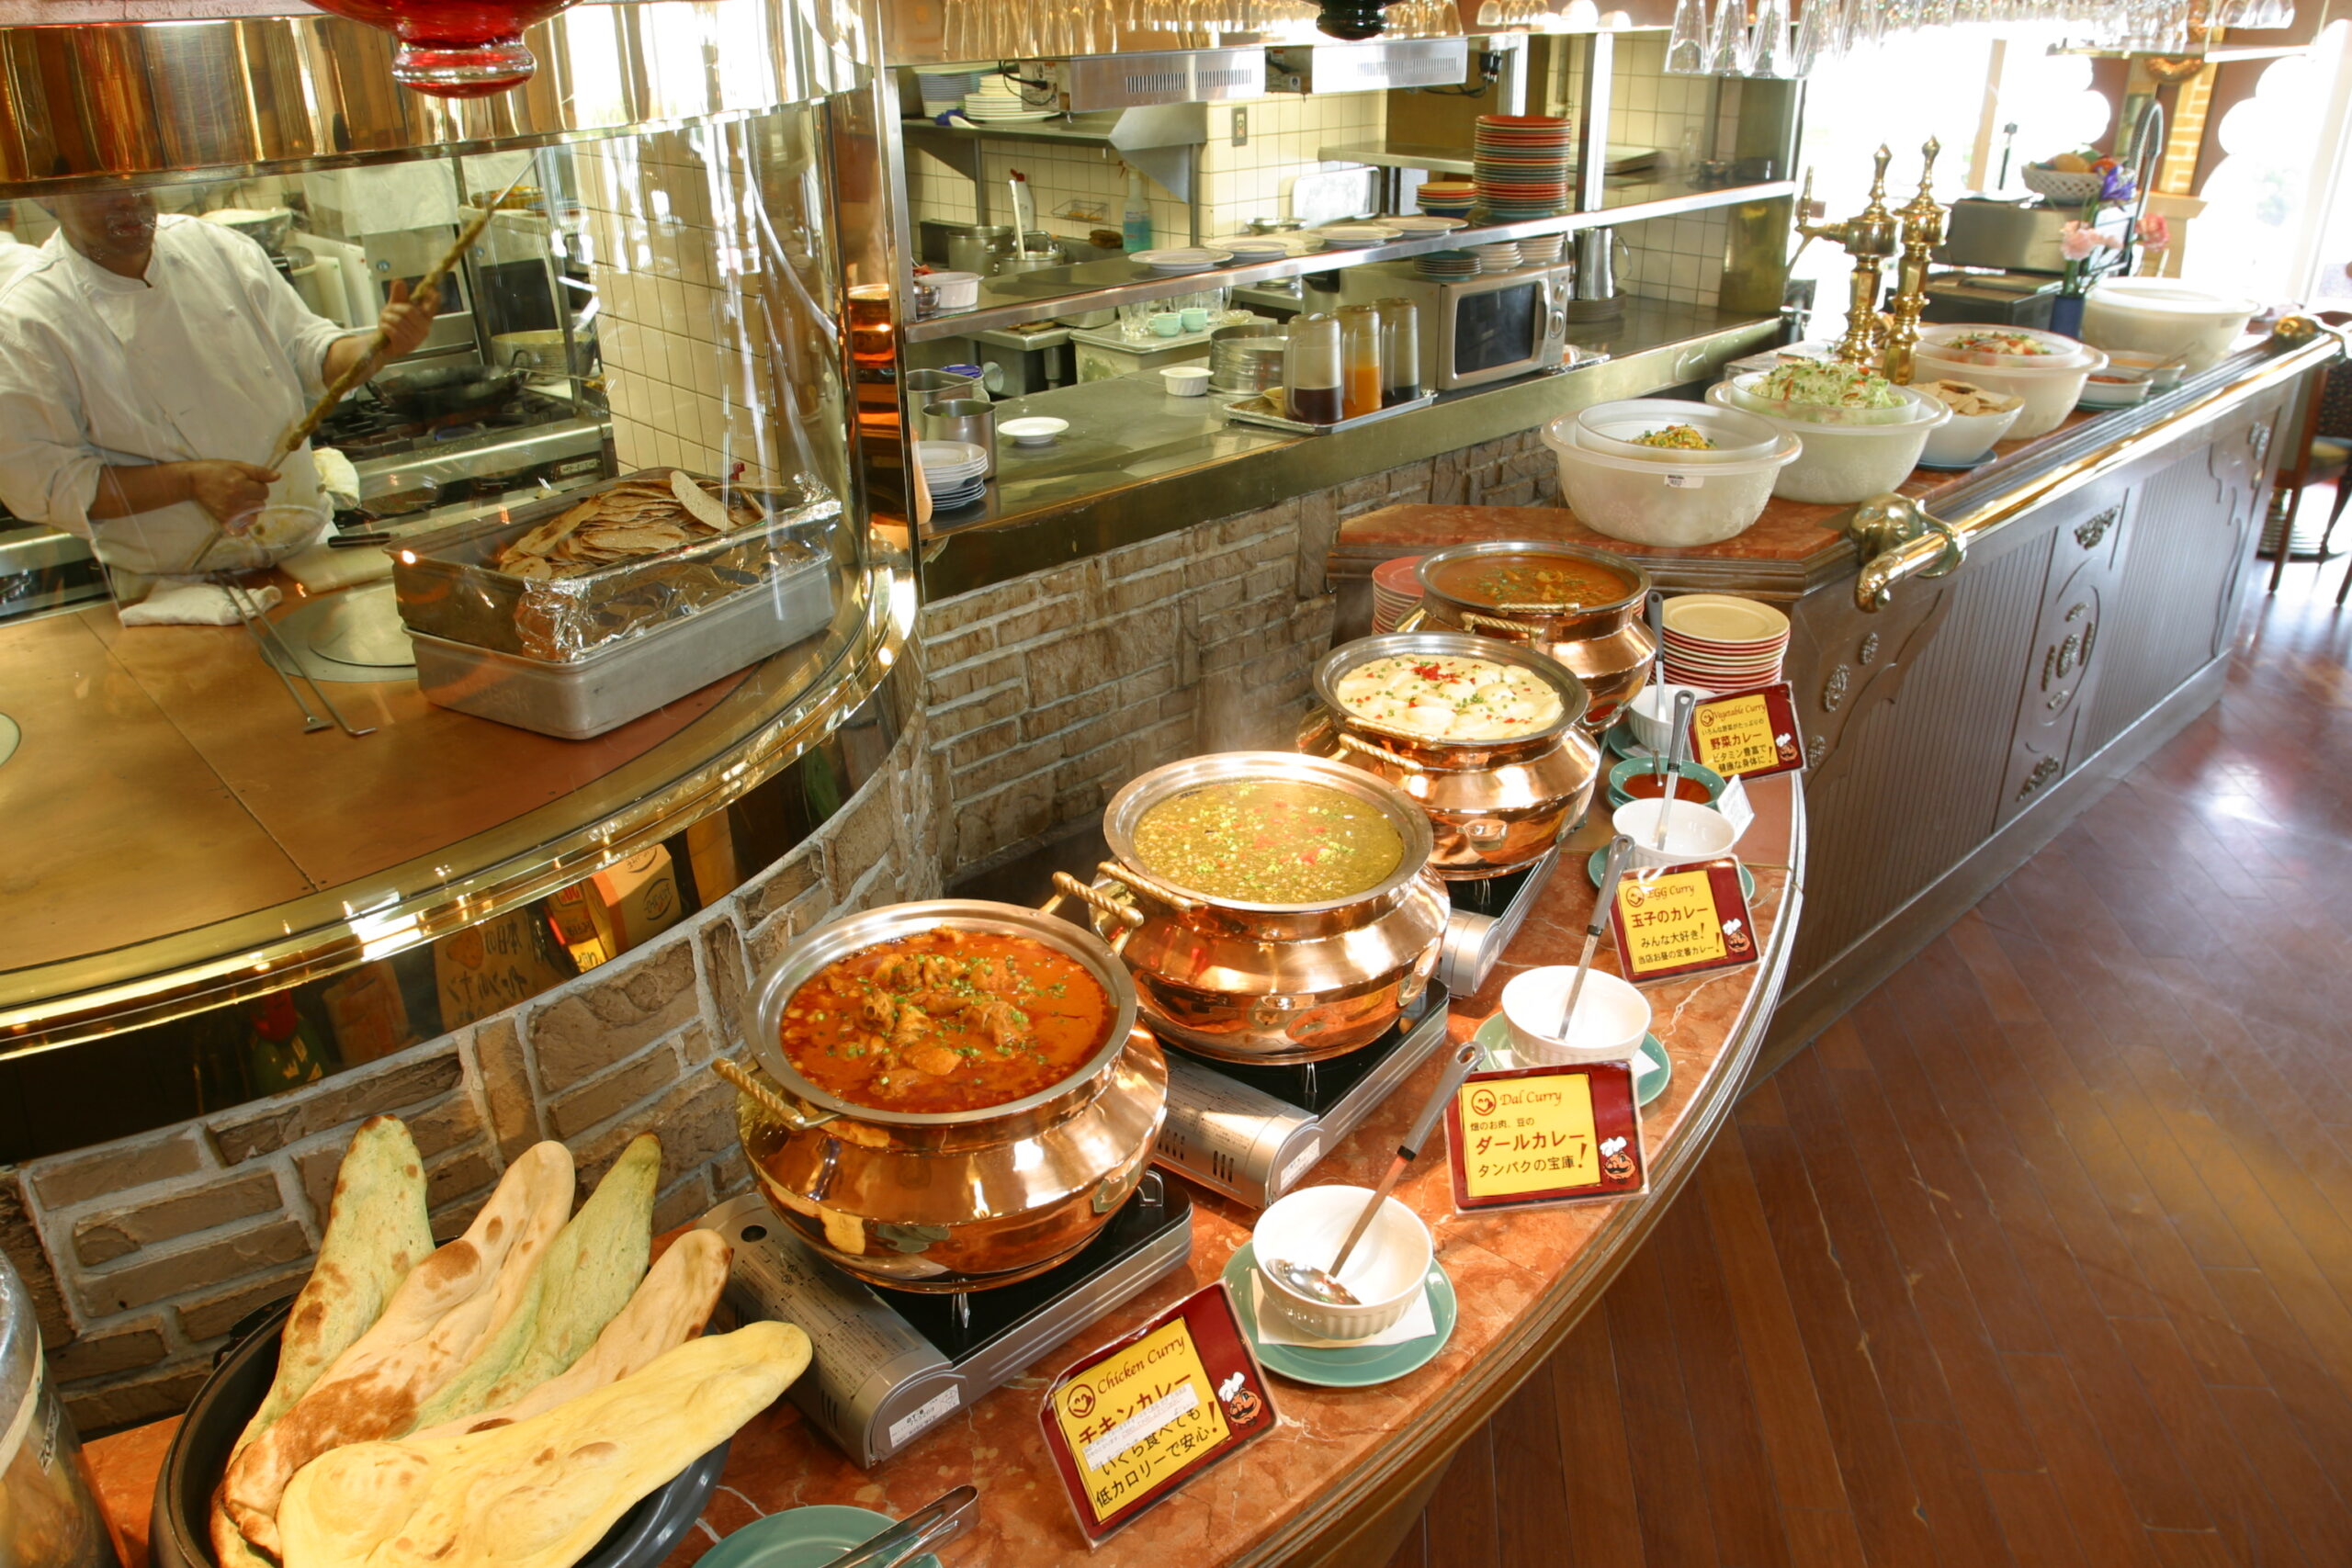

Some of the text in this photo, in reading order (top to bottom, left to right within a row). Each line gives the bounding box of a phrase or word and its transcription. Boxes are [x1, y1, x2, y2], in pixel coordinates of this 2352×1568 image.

[1713, 704, 1767, 721] Vegetable Curry
[1710, 732, 1762, 750] 野菜カレー
[1713, 744, 1768, 763] ビタミン豊富で
[1647, 885, 1695, 901] EGG Curry
[1631, 906, 1709, 929] 玉子のカレー
[1640, 922, 1705, 949] みんな大好き!
[1499, 1089, 1563, 1108] Dal Curry
[1476, 1130, 1586, 1156] ダールカレー
[1477, 1143, 1589, 1179] タンパクの宝庫!
[1096, 1335, 1185, 1395] Chicken Curry
